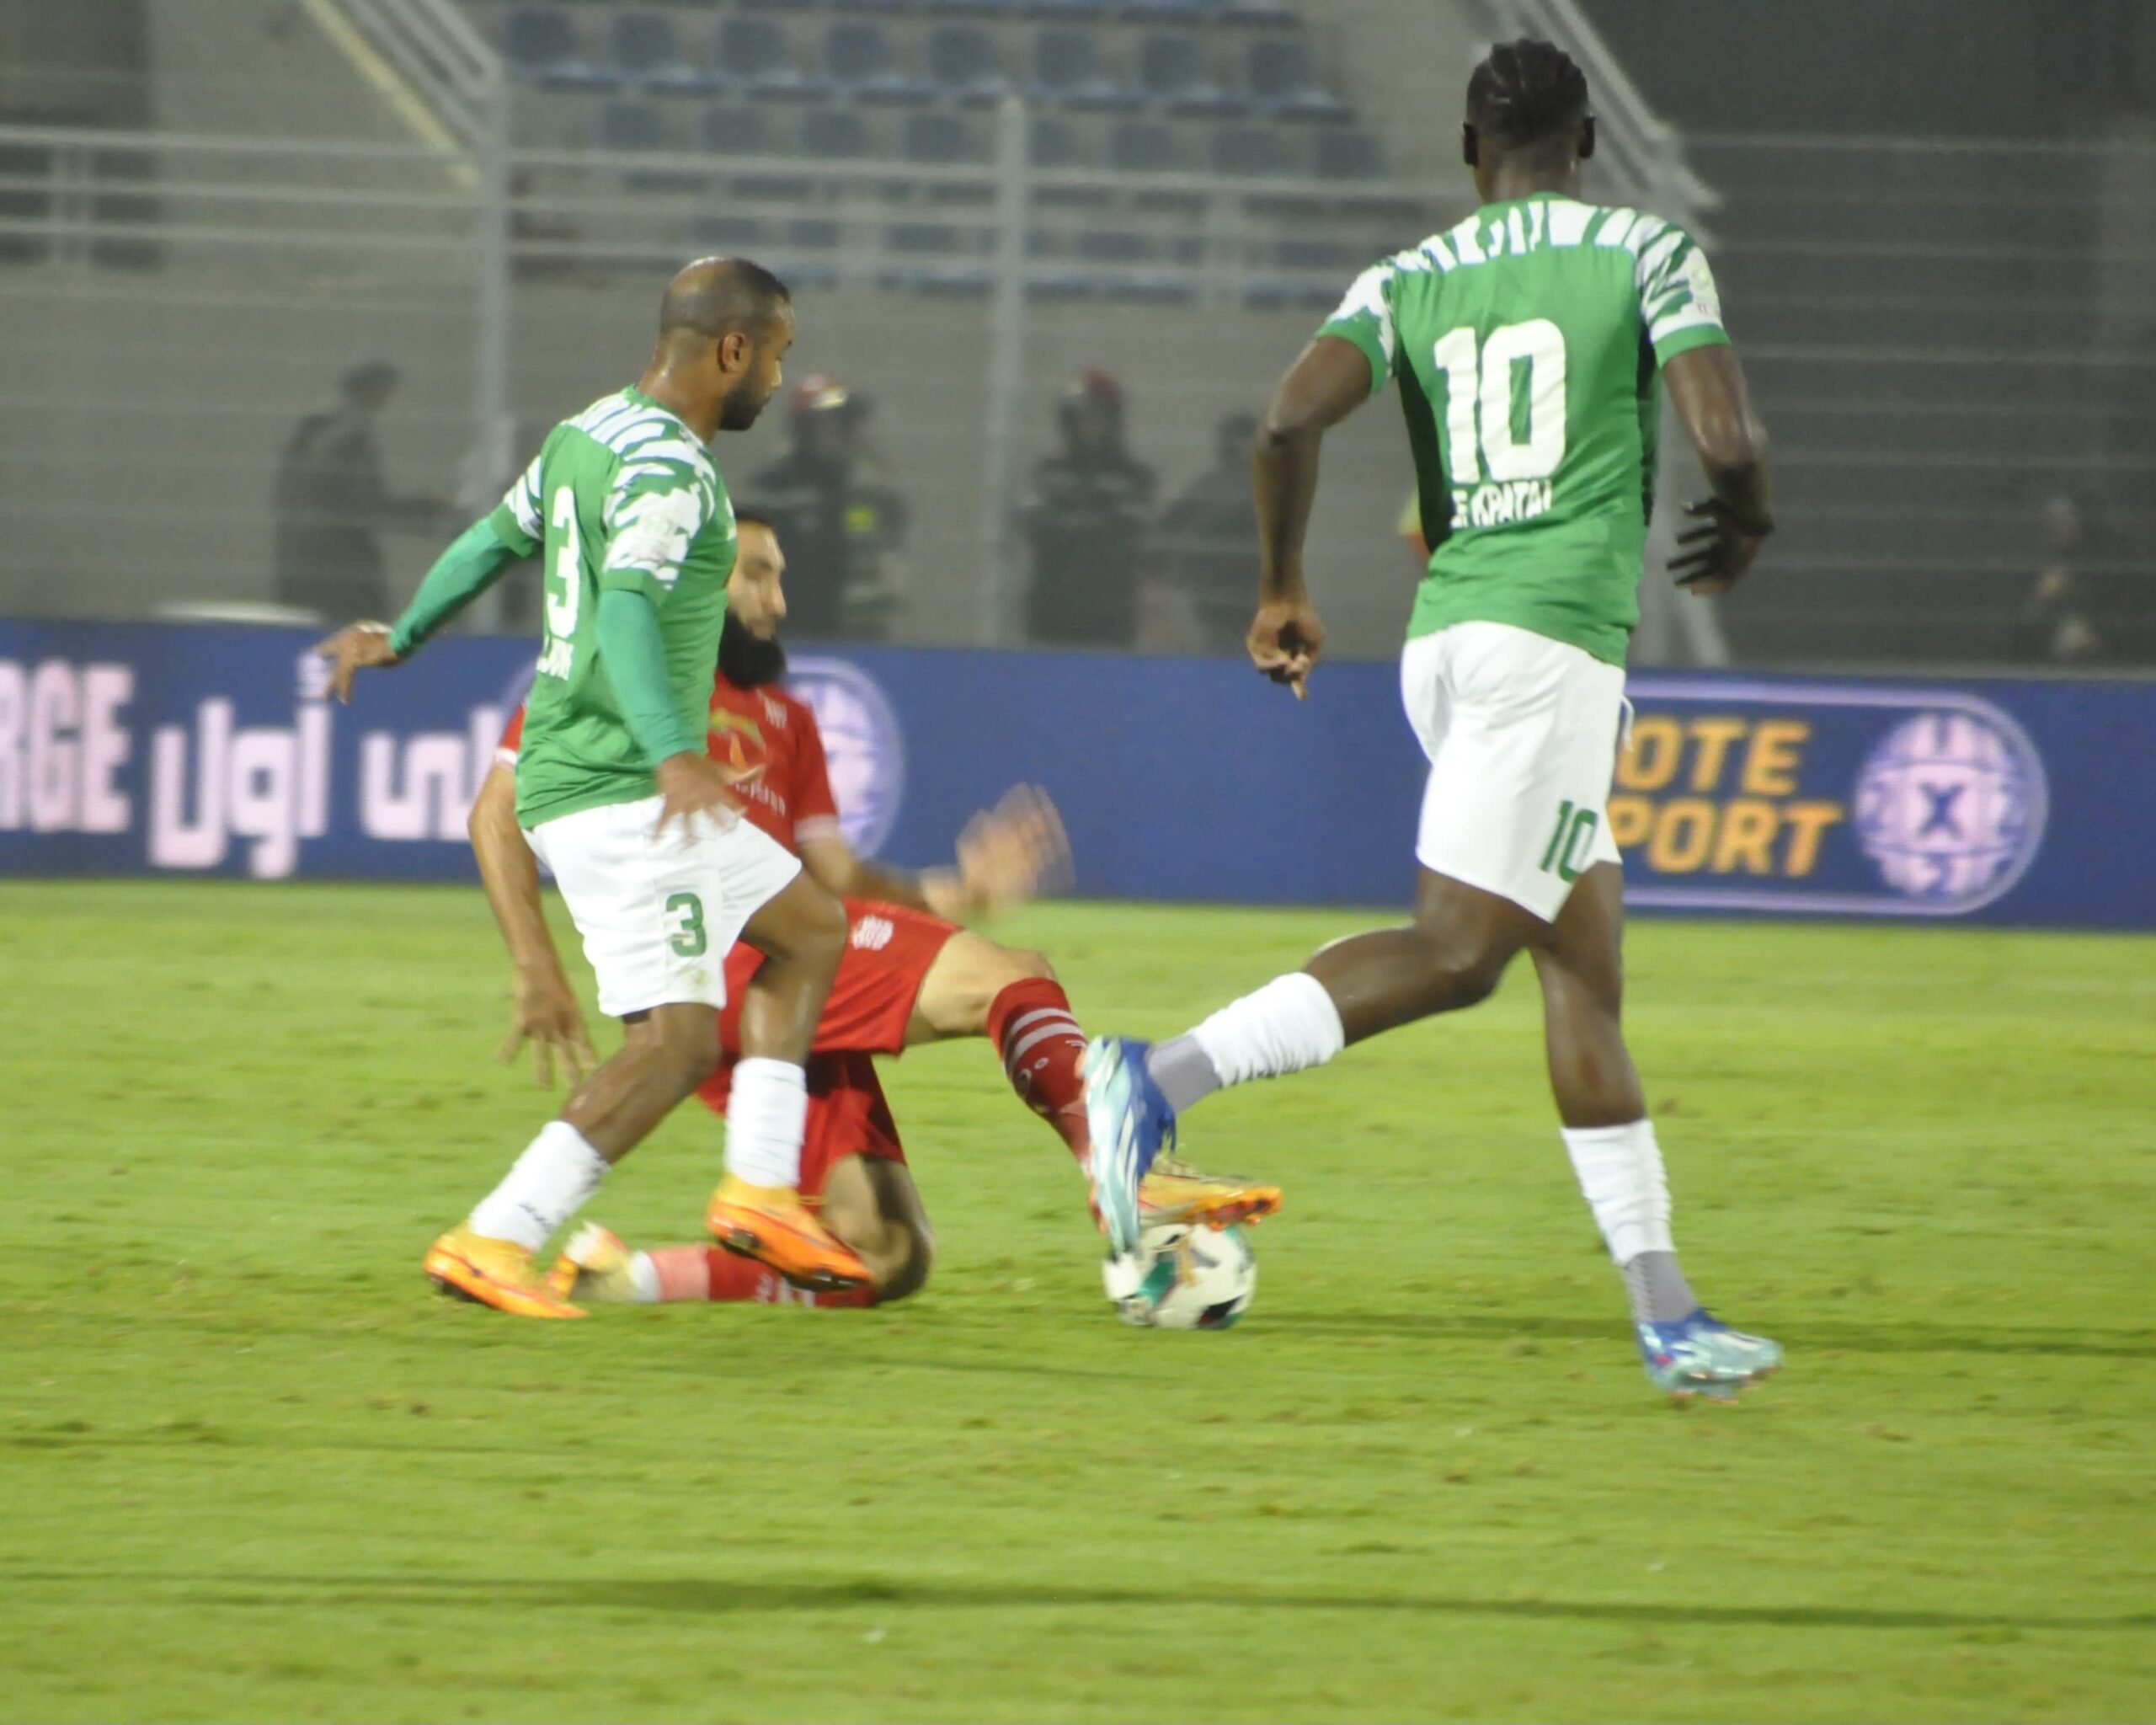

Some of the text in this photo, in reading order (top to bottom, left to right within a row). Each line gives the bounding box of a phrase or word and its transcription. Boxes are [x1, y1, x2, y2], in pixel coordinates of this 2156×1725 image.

[1434, 318, 1566, 483] 10
[547, 486, 580, 638] 3
[1616, 718, 1811, 796] OTE
[1540, 800, 1598, 884] 10
[1606, 795, 1844, 877] PORT
[666, 892, 707, 958] 3
